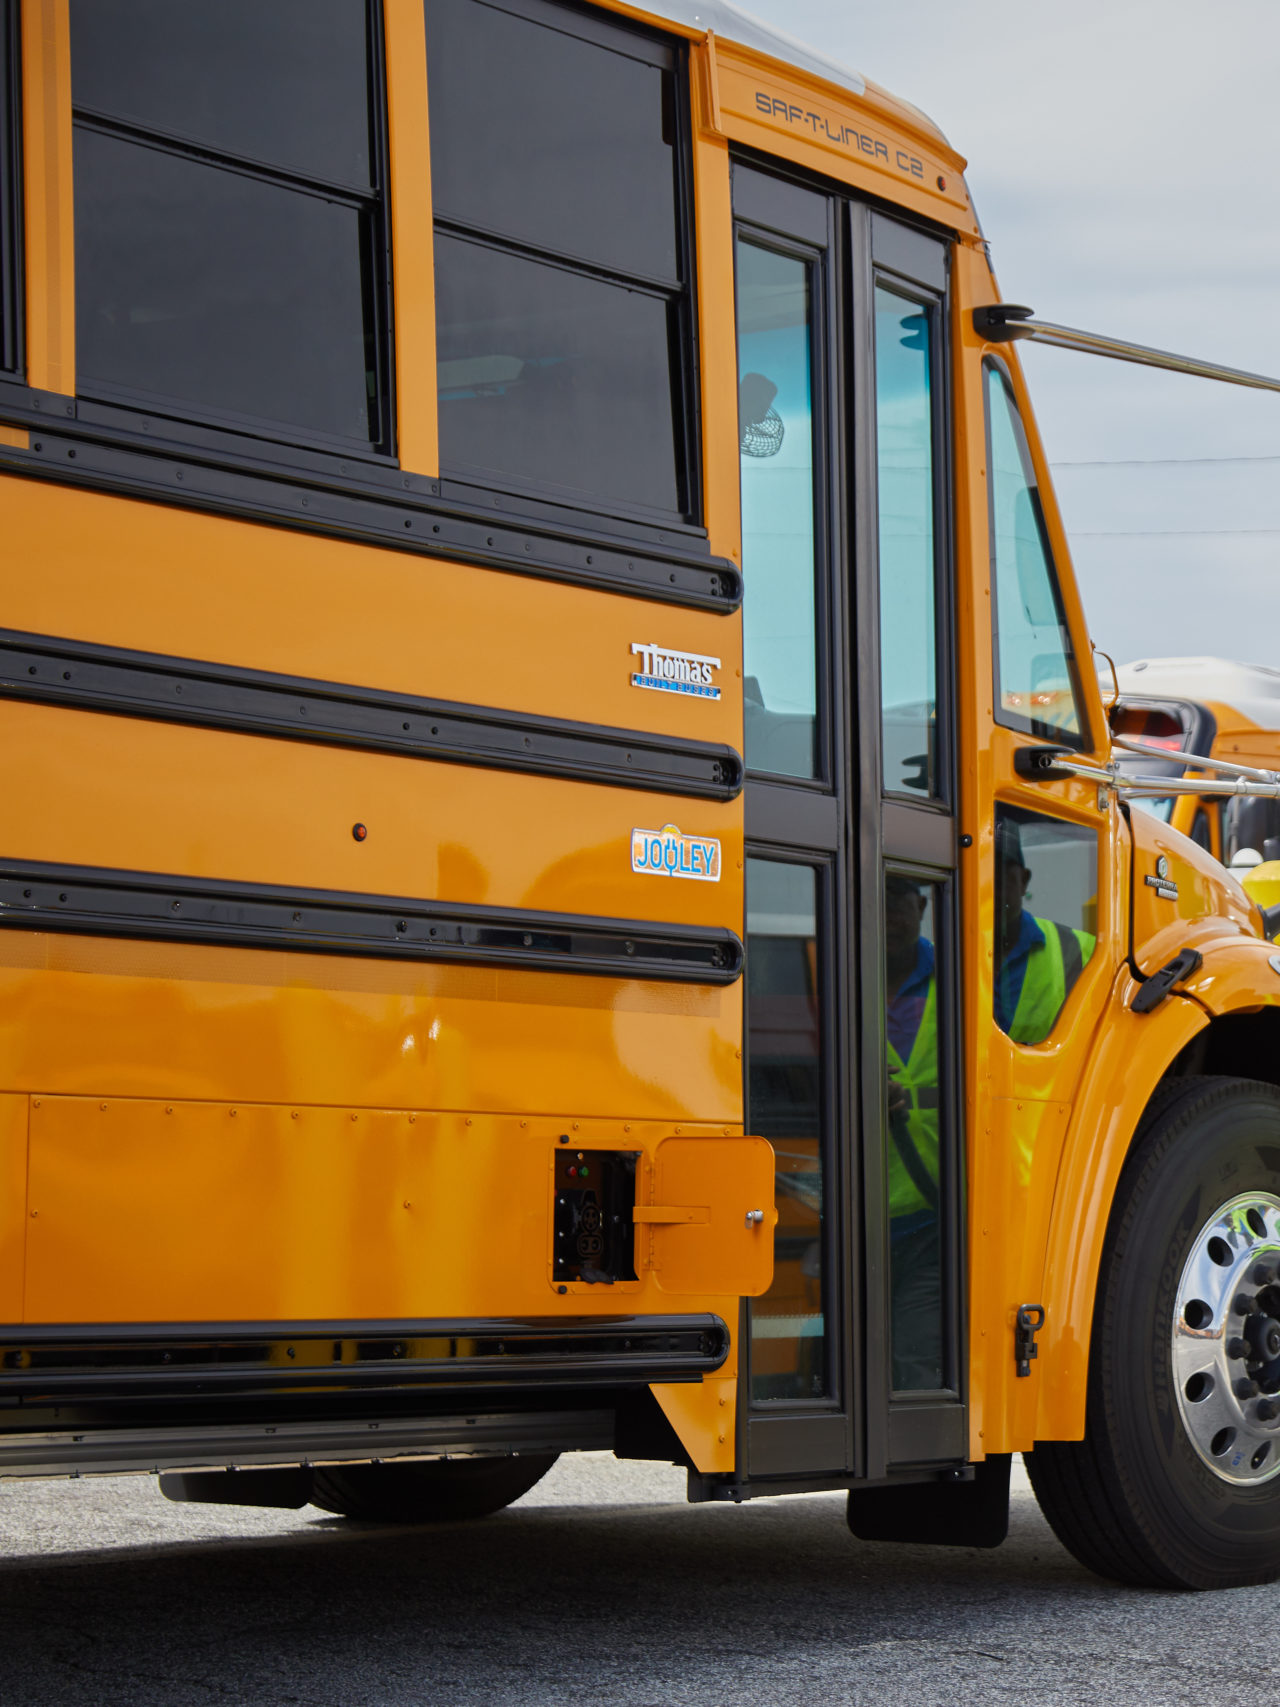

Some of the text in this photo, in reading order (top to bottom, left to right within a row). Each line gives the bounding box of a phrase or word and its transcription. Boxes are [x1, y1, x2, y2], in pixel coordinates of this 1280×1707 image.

[896, 151, 924, 179] C2
[632, 642, 721, 685] Thomas
[637, 838, 715, 876] JOULEY
